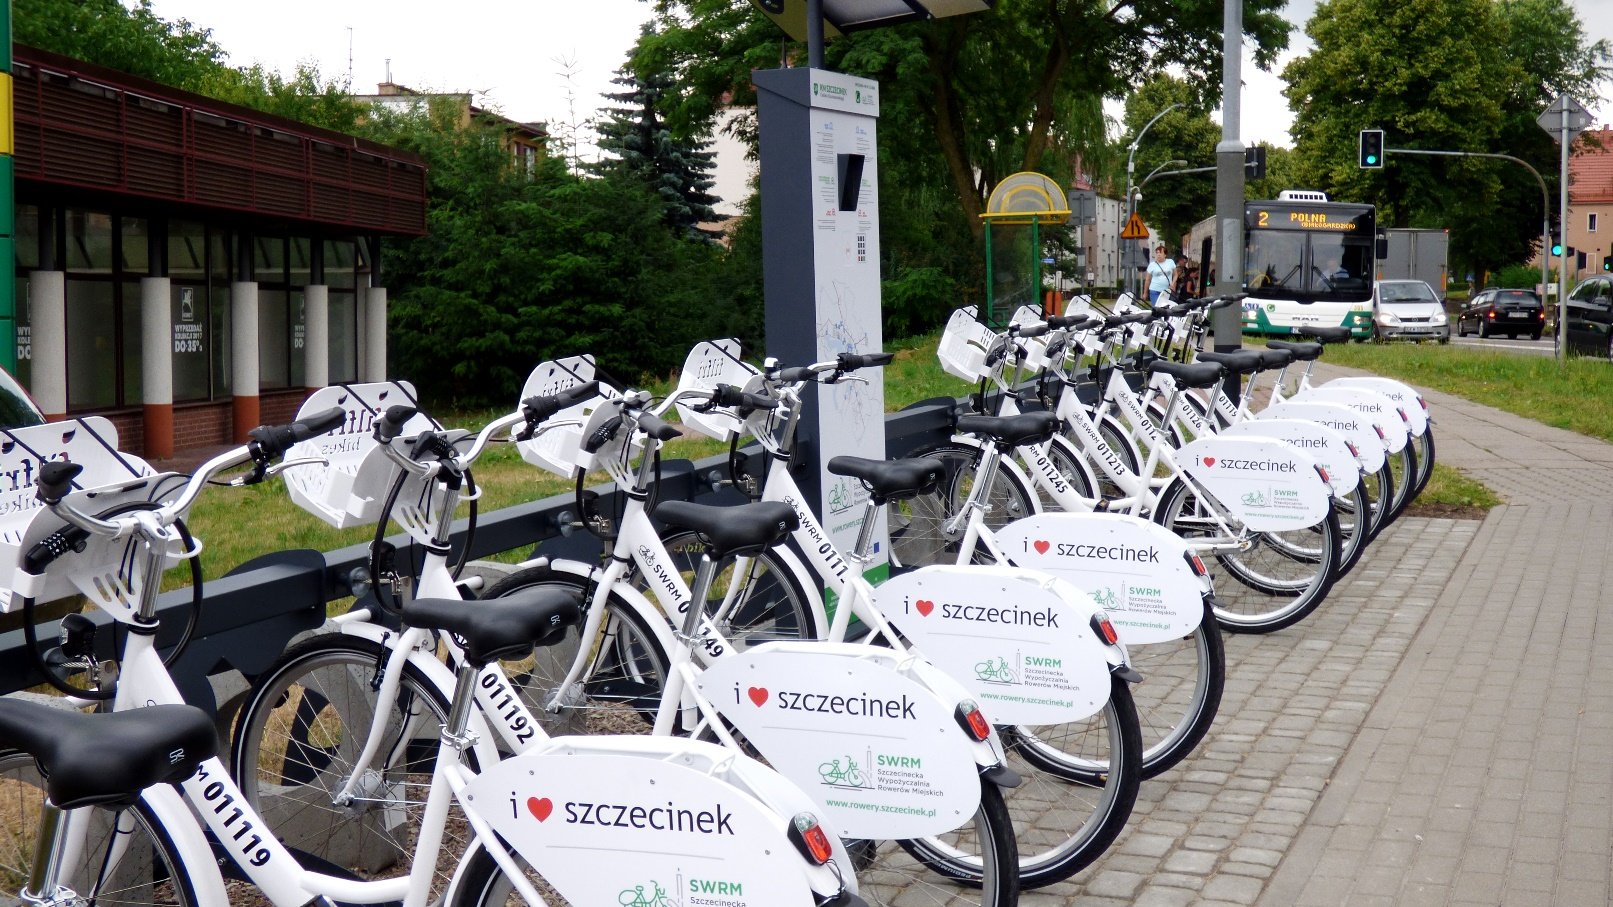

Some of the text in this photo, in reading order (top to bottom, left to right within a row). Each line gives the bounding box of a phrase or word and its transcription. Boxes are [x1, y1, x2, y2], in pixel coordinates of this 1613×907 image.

[1258, 211, 1326, 226] 2 POLNA
[17, 345, 31, 360] DO
[1127, 400, 1144, 420] SWRM
[1082, 422, 1126, 476] SWRM 011213
[1220, 459, 1297, 473] szczecinek
[1037, 457, 1069, 493] 011245
[798, 511, 849, 584] SWRM 0111
[1023, 537, 1160, 564] i szczecinek
[653, 564, 682, 601] SWRM
[1129, 586, 1161, 597] SWRM
[903, 596, 1059, 629] i szczecinek
[1113, 619, 1171, 631] wery.szczecinek.pl
[1025, 656, 1062, 668] SWRM
[1024, 668, 1064, 677] Szczecinecka
[481, 673, 535, 745] 011192
[734, 682, 917, 720] i szczecinek
[980, 692, 1073, 709] www.rowery.szczecinek.pl
[877, 754, 921, 769] SWRM
[877, 769, 924, 779] Szczecinecka
[877, 777, 930, 789] Wypożyczalnia
[877, 784, 944, 798] Rowerów Miejskich
[510, 791, 735, 835] i szczecinek
[826, 798, 937, 818] www.rowery.szczecinek.pl
[203, 781, 271, 867] 011119
[689, 879, 743, 896] SWRM
[690, 896, 746, 907] Szczecinecka
